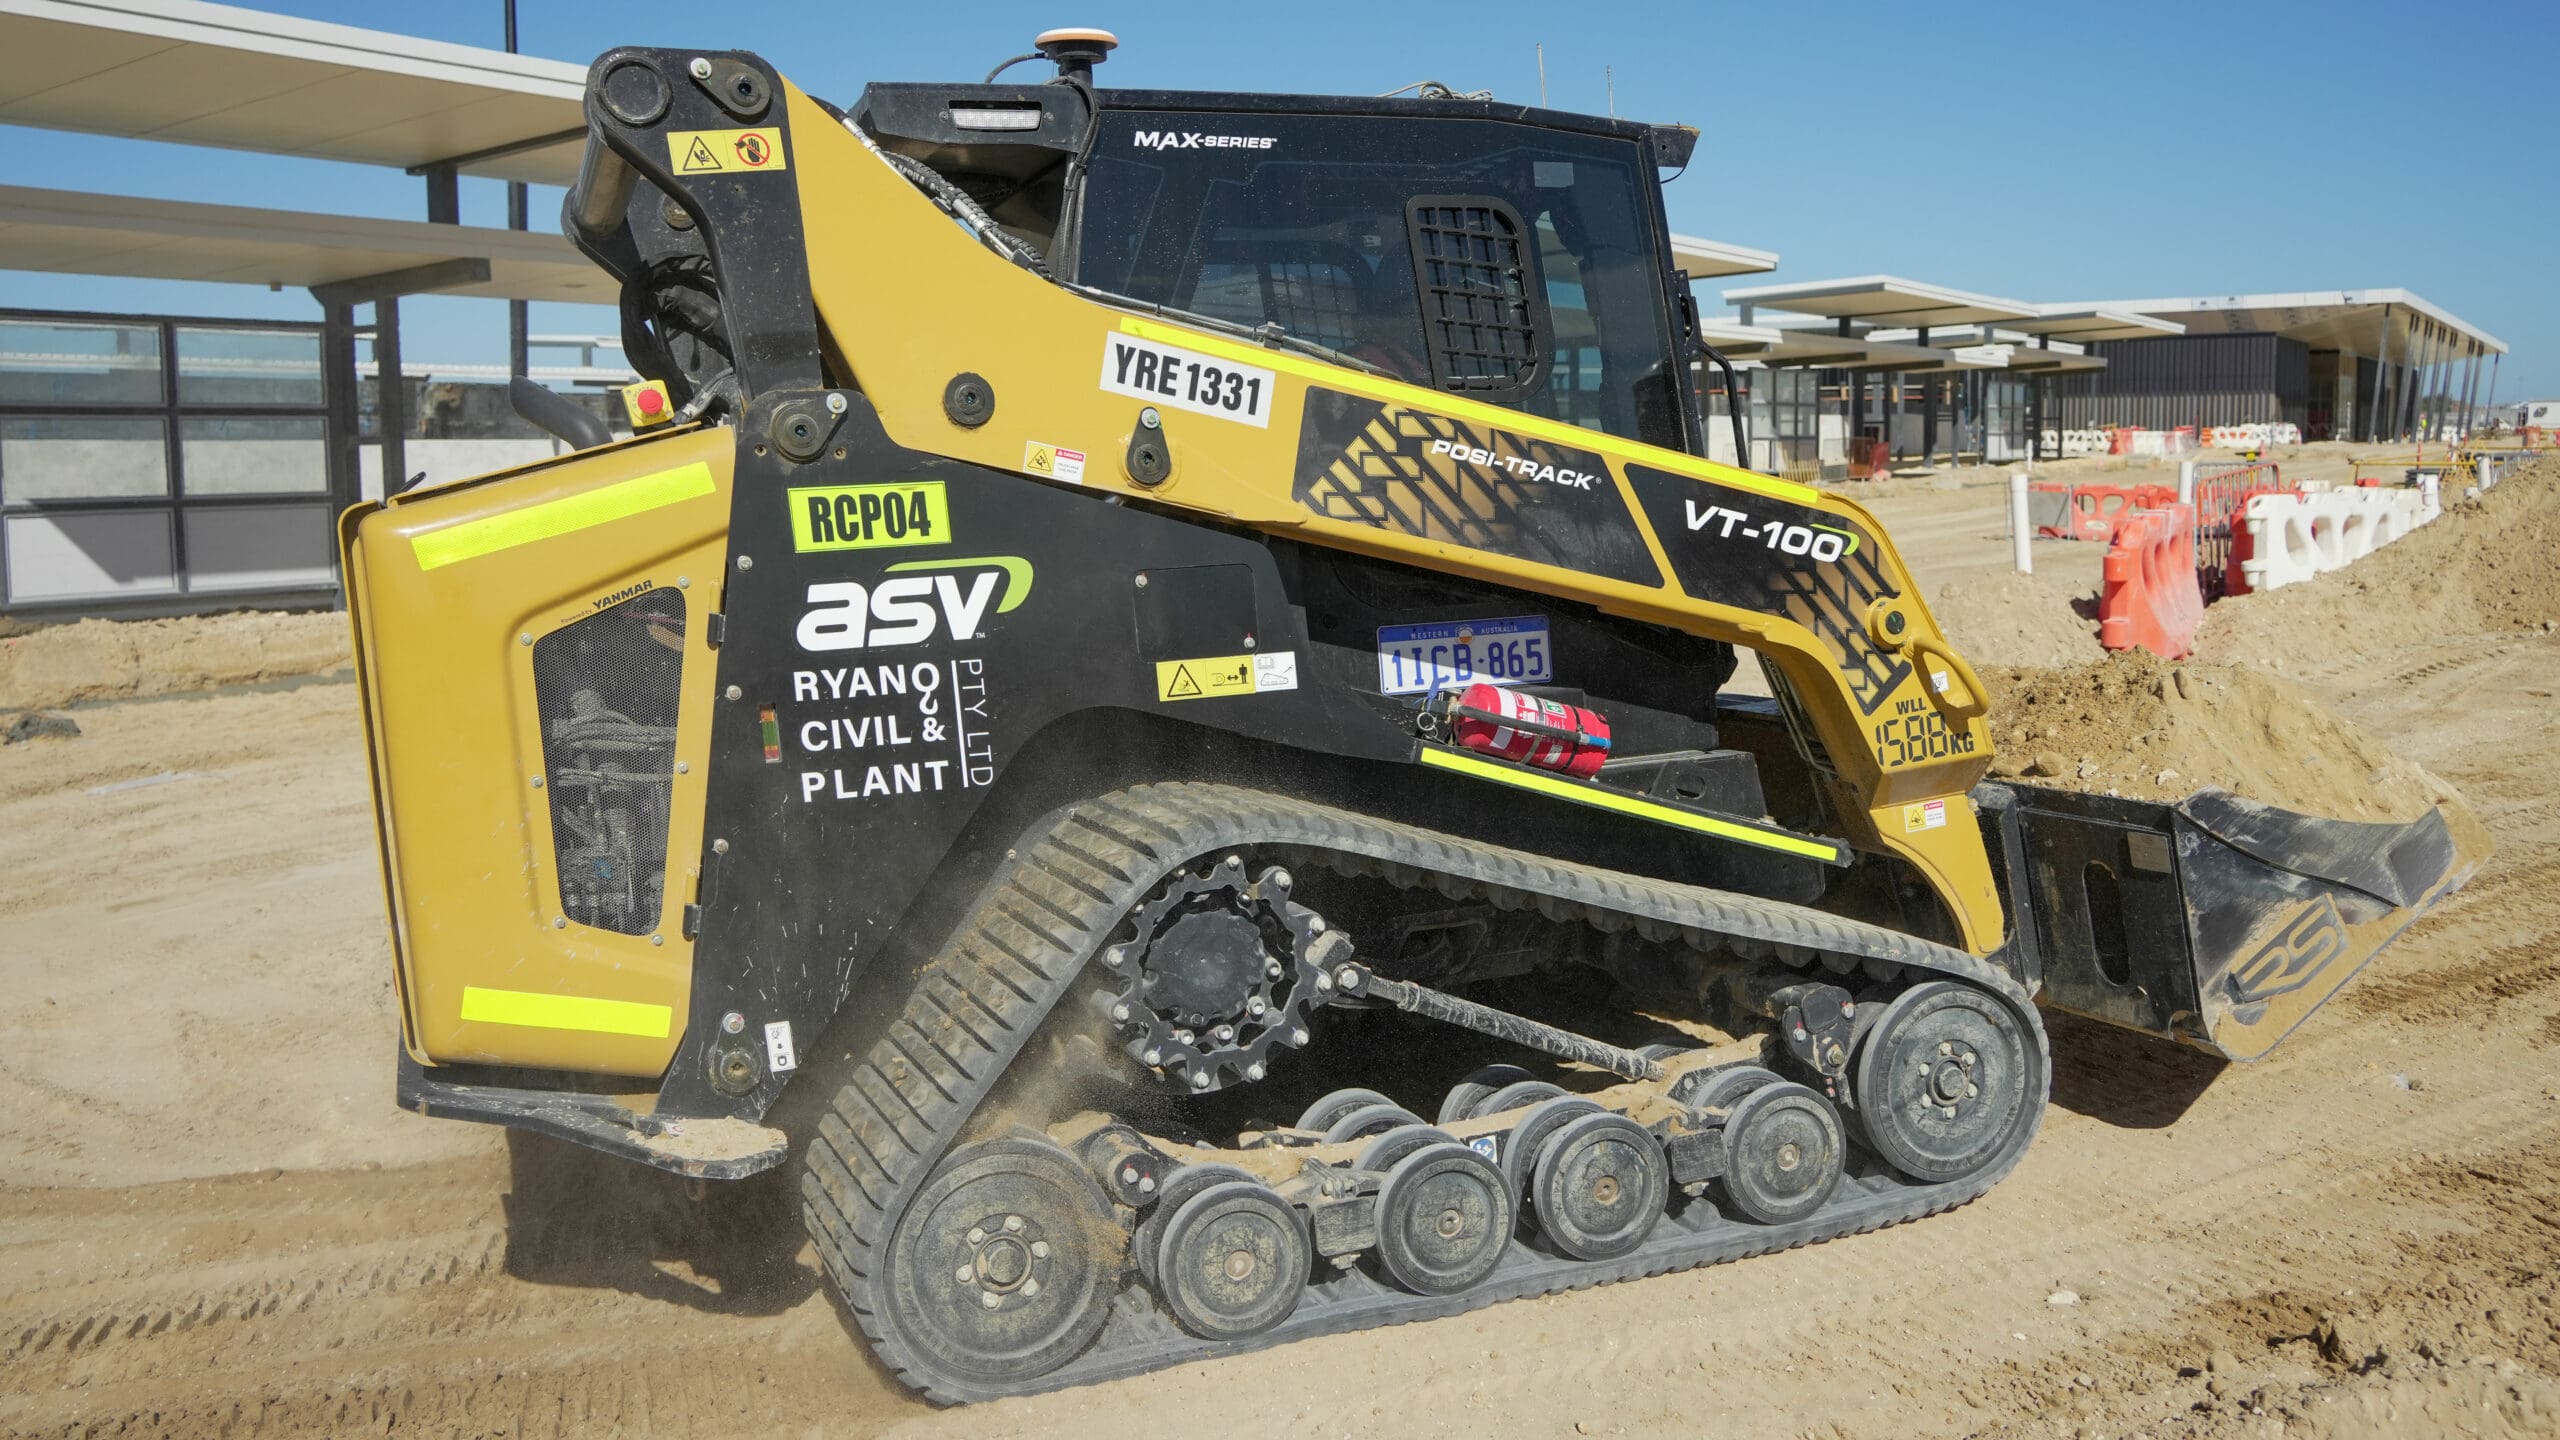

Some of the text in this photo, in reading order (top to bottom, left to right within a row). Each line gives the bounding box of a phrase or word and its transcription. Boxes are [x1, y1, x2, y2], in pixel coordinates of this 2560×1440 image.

[1115, 343, 1261, 416] YRE 1331
[807, 490, 931, 543] RCP04
[1685, 499, 1843, 562] VT-100
[592, 579, 653, 610] YANMAR
[1410, 624, 1518, 640] WESTERN AUSTRALIA
[793, 664, 907, 702] RYAN
[959, 658, 994, 786] PTY LTD
[1896, 697, 1927, 715] WLL
[800, 715, 947, 752] CIVIL &
[801, 760, 949, 803] PLANT
